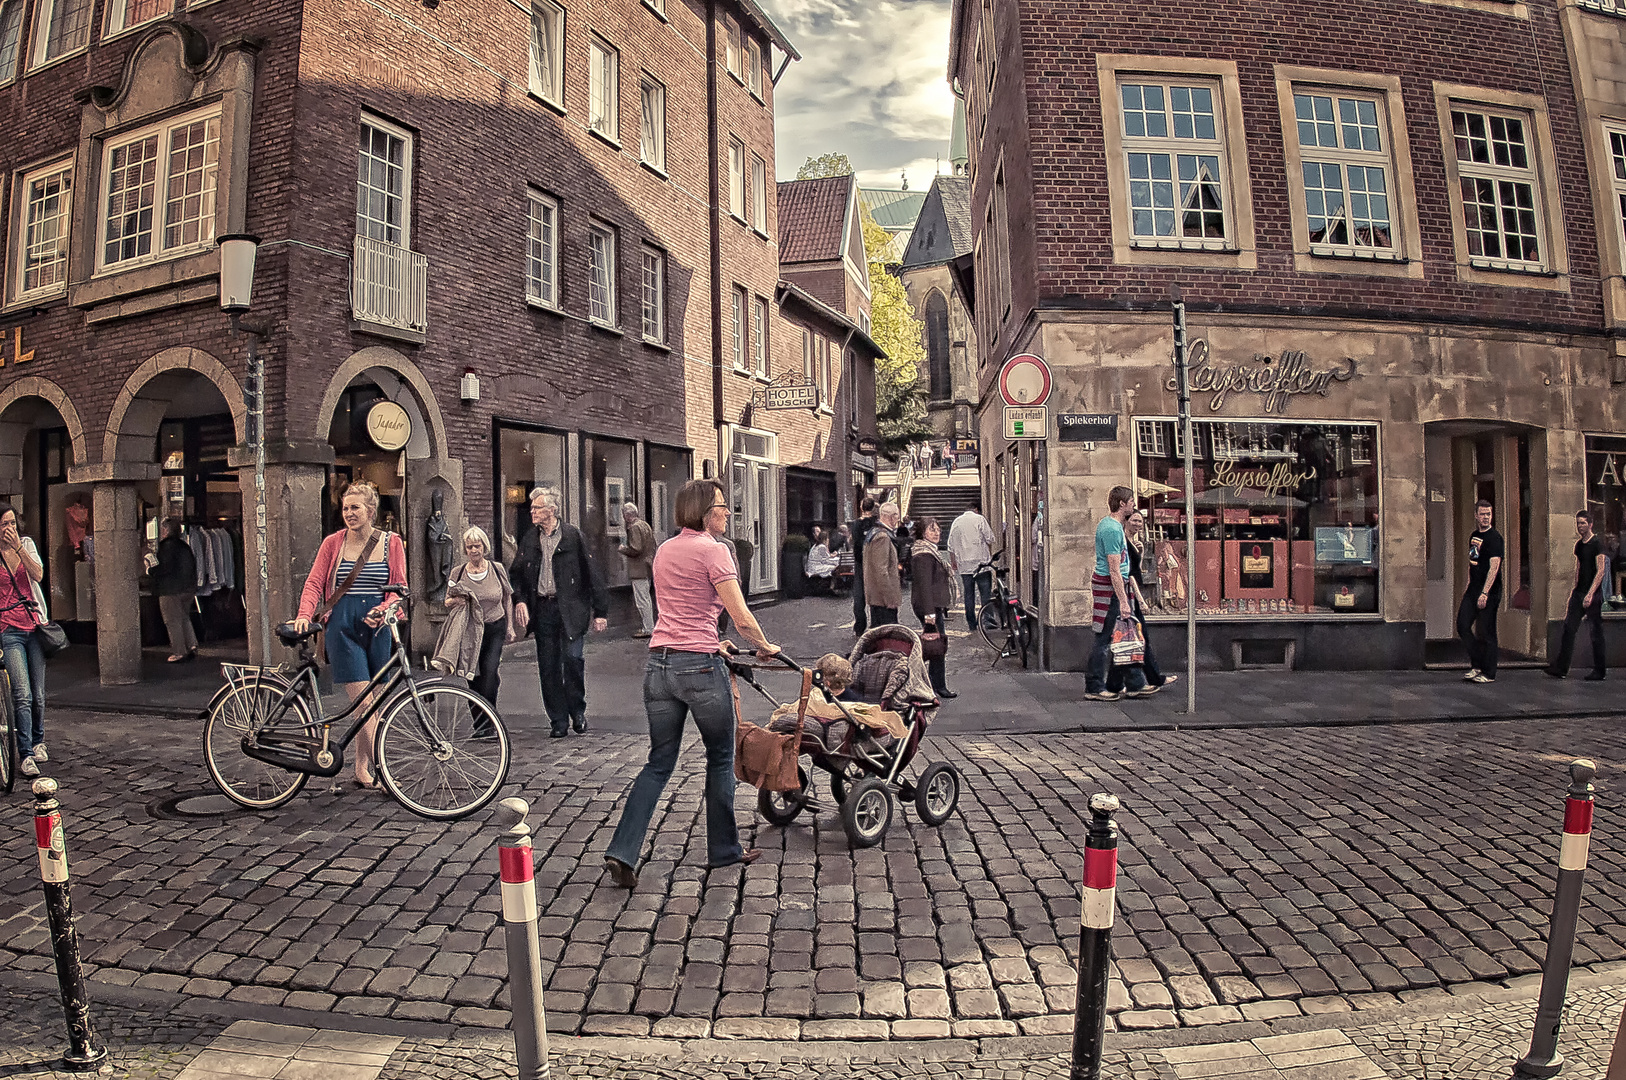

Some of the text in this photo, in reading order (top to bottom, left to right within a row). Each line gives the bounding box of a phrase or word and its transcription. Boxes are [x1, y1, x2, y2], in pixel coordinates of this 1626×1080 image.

[1165, 338, 1357, 413] Leysieffer
[768, 388, 815, 399] HOTEL
[768, 398, 815, 407] BUSCHE
[1063, 415, 1112, 426] Spiekerhof
[1209, 457, 1317, 498] Leysieffer
